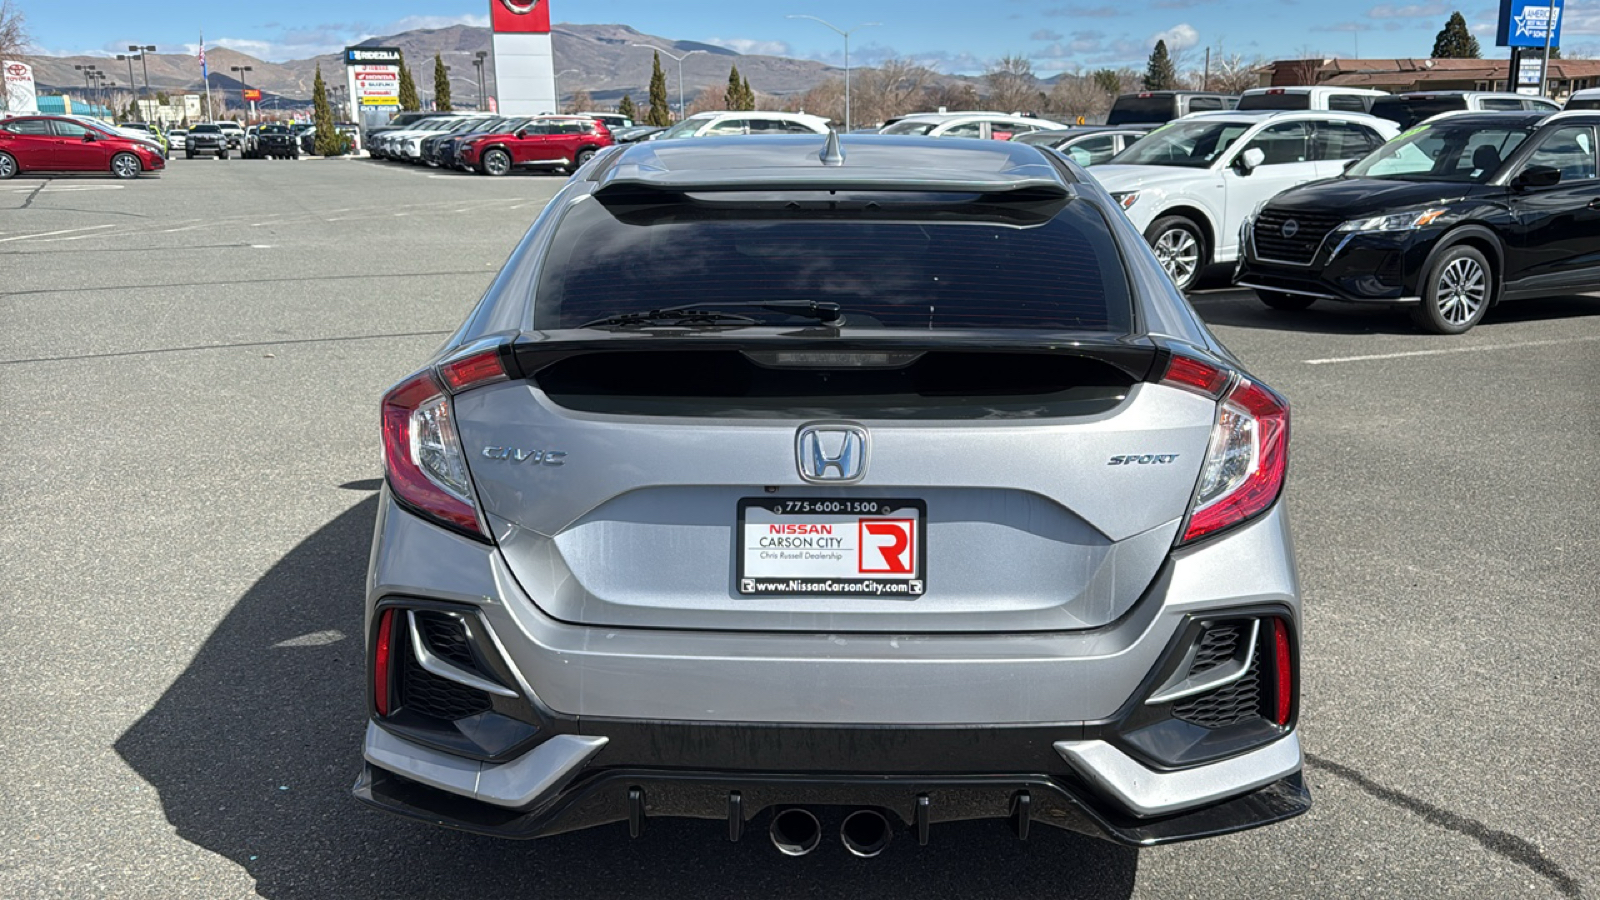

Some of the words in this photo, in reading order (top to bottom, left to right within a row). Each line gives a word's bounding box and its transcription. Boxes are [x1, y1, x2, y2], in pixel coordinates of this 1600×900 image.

[361, 50, 400, 60] RIDEZILLA
[482, 446, 568, 465] CIVIC
[1107, 454, 1180, 465] SPORT
[786, 501, 878, 512] 775-600-1500
[769, 524, 832, 535] NISSAN
[759, 537, 813, 548] CARSON
[816, 537, 843, 548] CITY
[760, 551, 778, 560] Chris
[780, 551, 803, 560] Russell
[805, 551, 843, 562] Dealership
[757, 580, 908, 595] www.NissanCarsonCity.com
